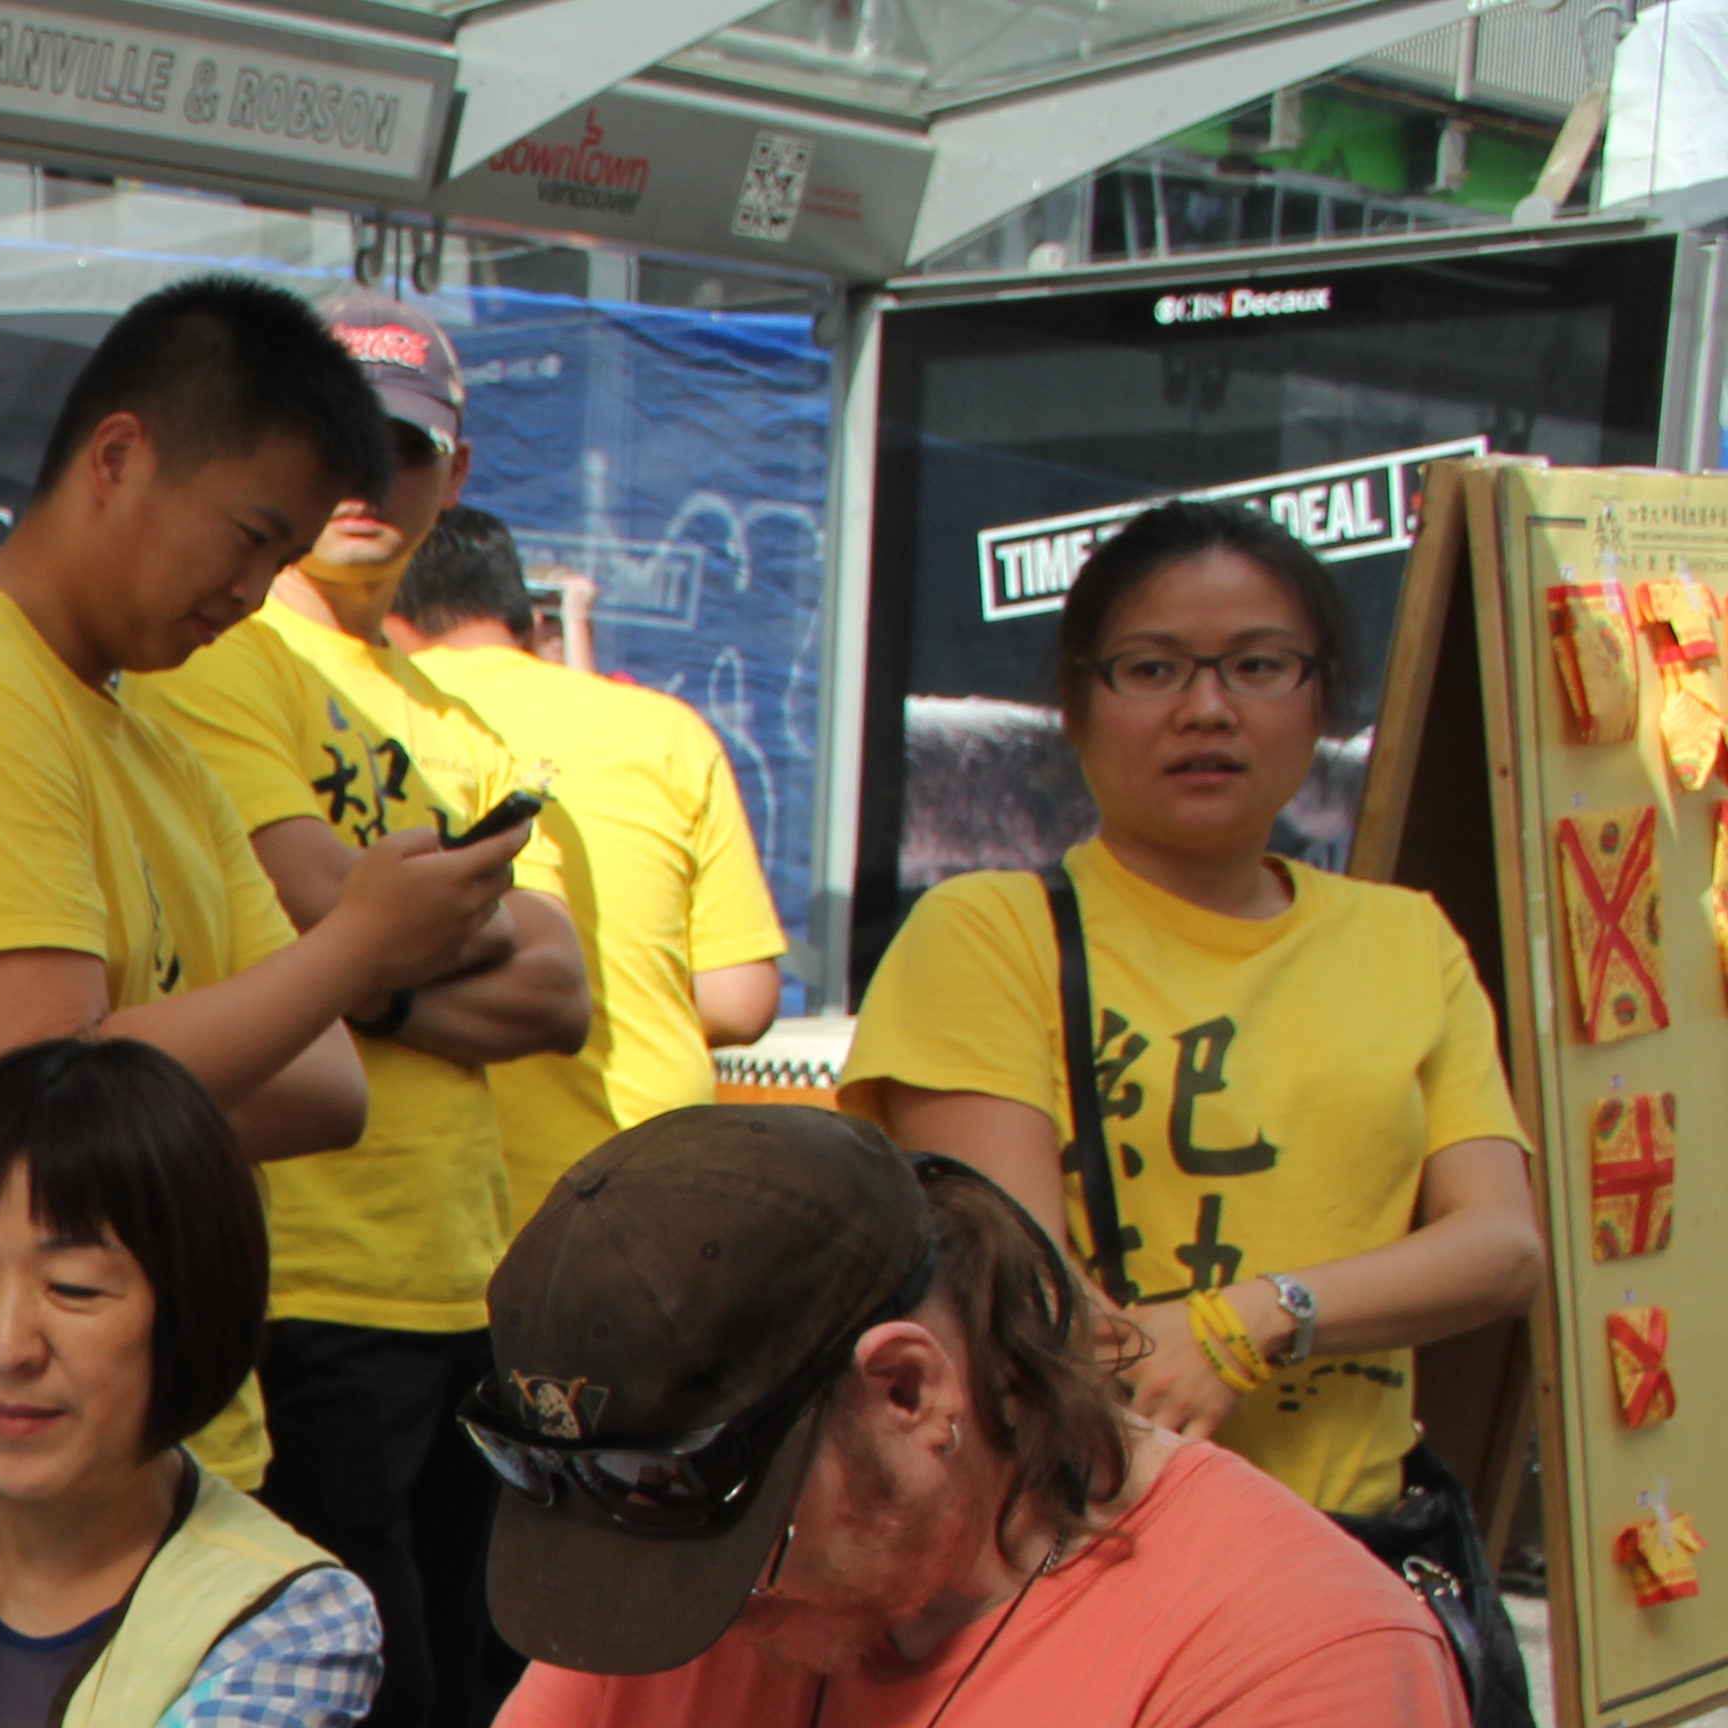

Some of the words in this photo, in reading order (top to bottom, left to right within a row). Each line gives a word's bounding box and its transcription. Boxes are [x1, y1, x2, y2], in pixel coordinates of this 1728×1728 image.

[183, 58, 221, 124] &
[228, 66, 399, 155] ROBSON
[1231, 287, 1332, 318] Decaux
